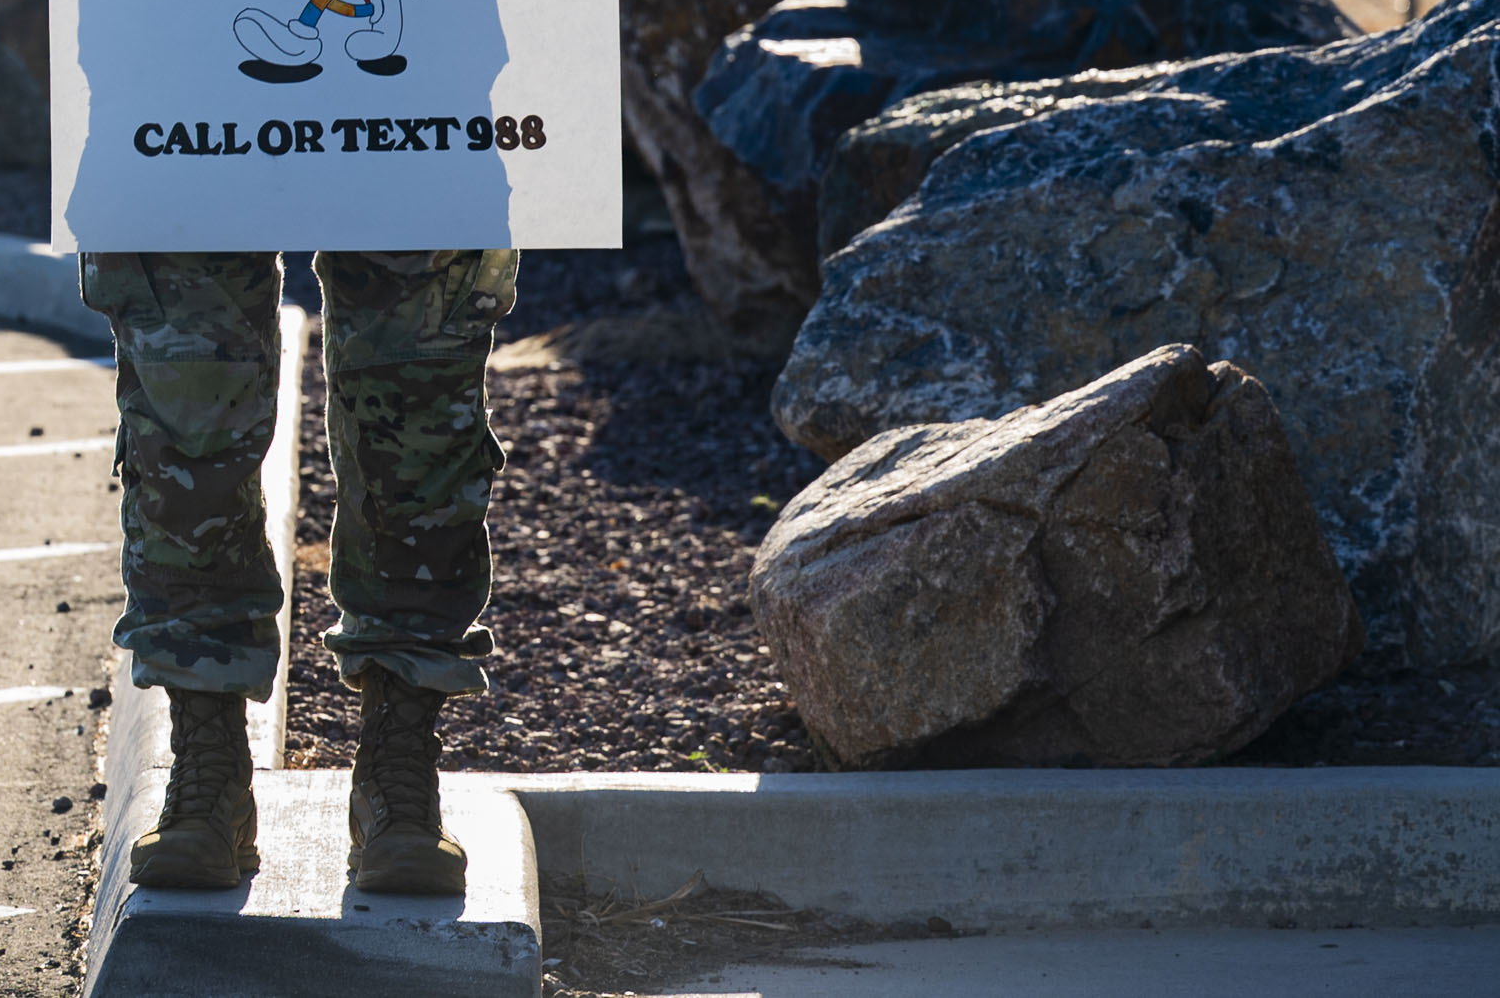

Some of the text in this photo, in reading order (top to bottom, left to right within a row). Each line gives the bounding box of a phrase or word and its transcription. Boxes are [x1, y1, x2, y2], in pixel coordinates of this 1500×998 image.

[133, 114, 547, 157] CALL OR TEXT 988
